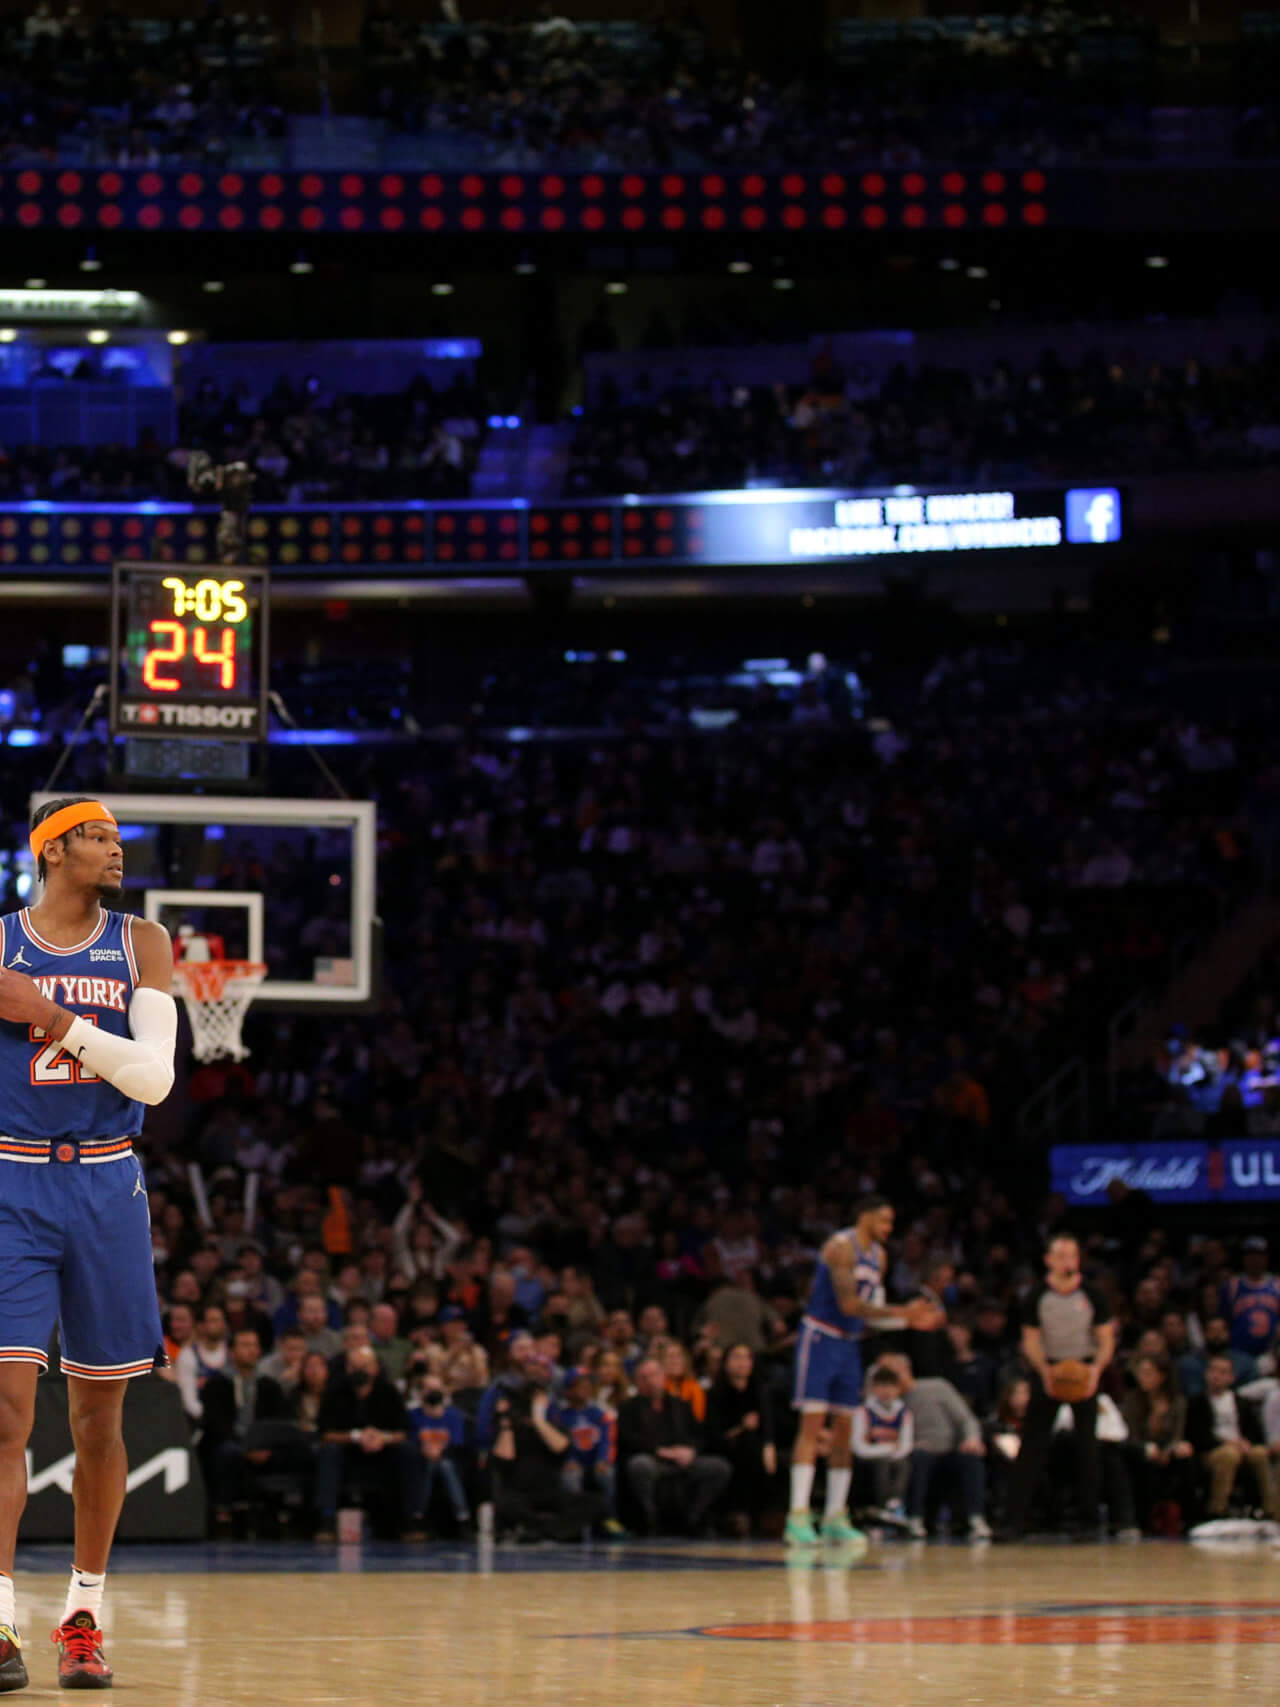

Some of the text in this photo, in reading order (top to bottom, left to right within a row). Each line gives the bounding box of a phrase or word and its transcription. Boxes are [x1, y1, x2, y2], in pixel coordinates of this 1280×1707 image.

[162, 577, 248, 622] 7:05
[143, 620, 235, 691] 24
[158, 704, 257, 728] TISSOT
[89, 948, 122, 956] SQUARE
[60, 976, 127, 1013] YORK
